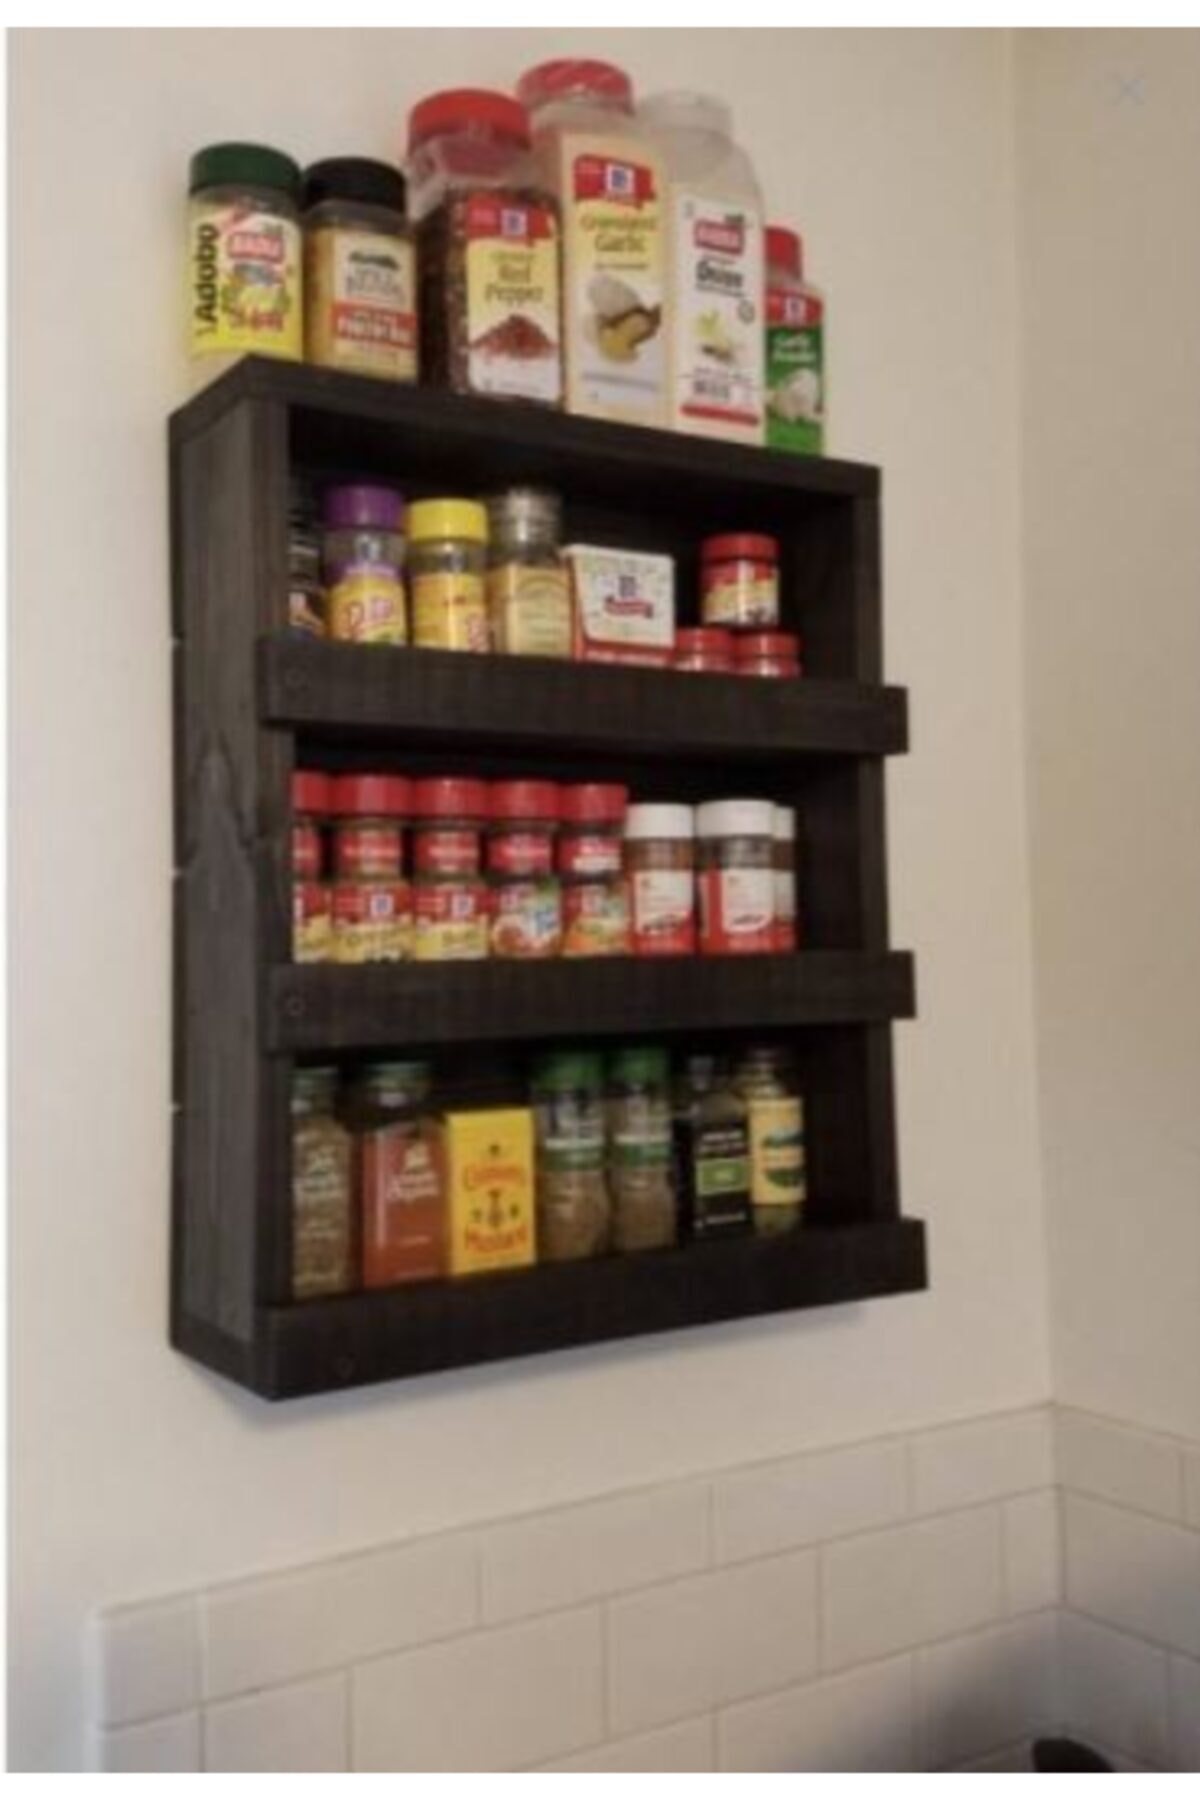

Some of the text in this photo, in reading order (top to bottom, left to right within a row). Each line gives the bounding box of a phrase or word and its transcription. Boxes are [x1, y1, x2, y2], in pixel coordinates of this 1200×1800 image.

[595, 233, 648, 254] Garlic
[194, 223, 220, 324] Adobo
[486, 284, 545, 307] Pepper
